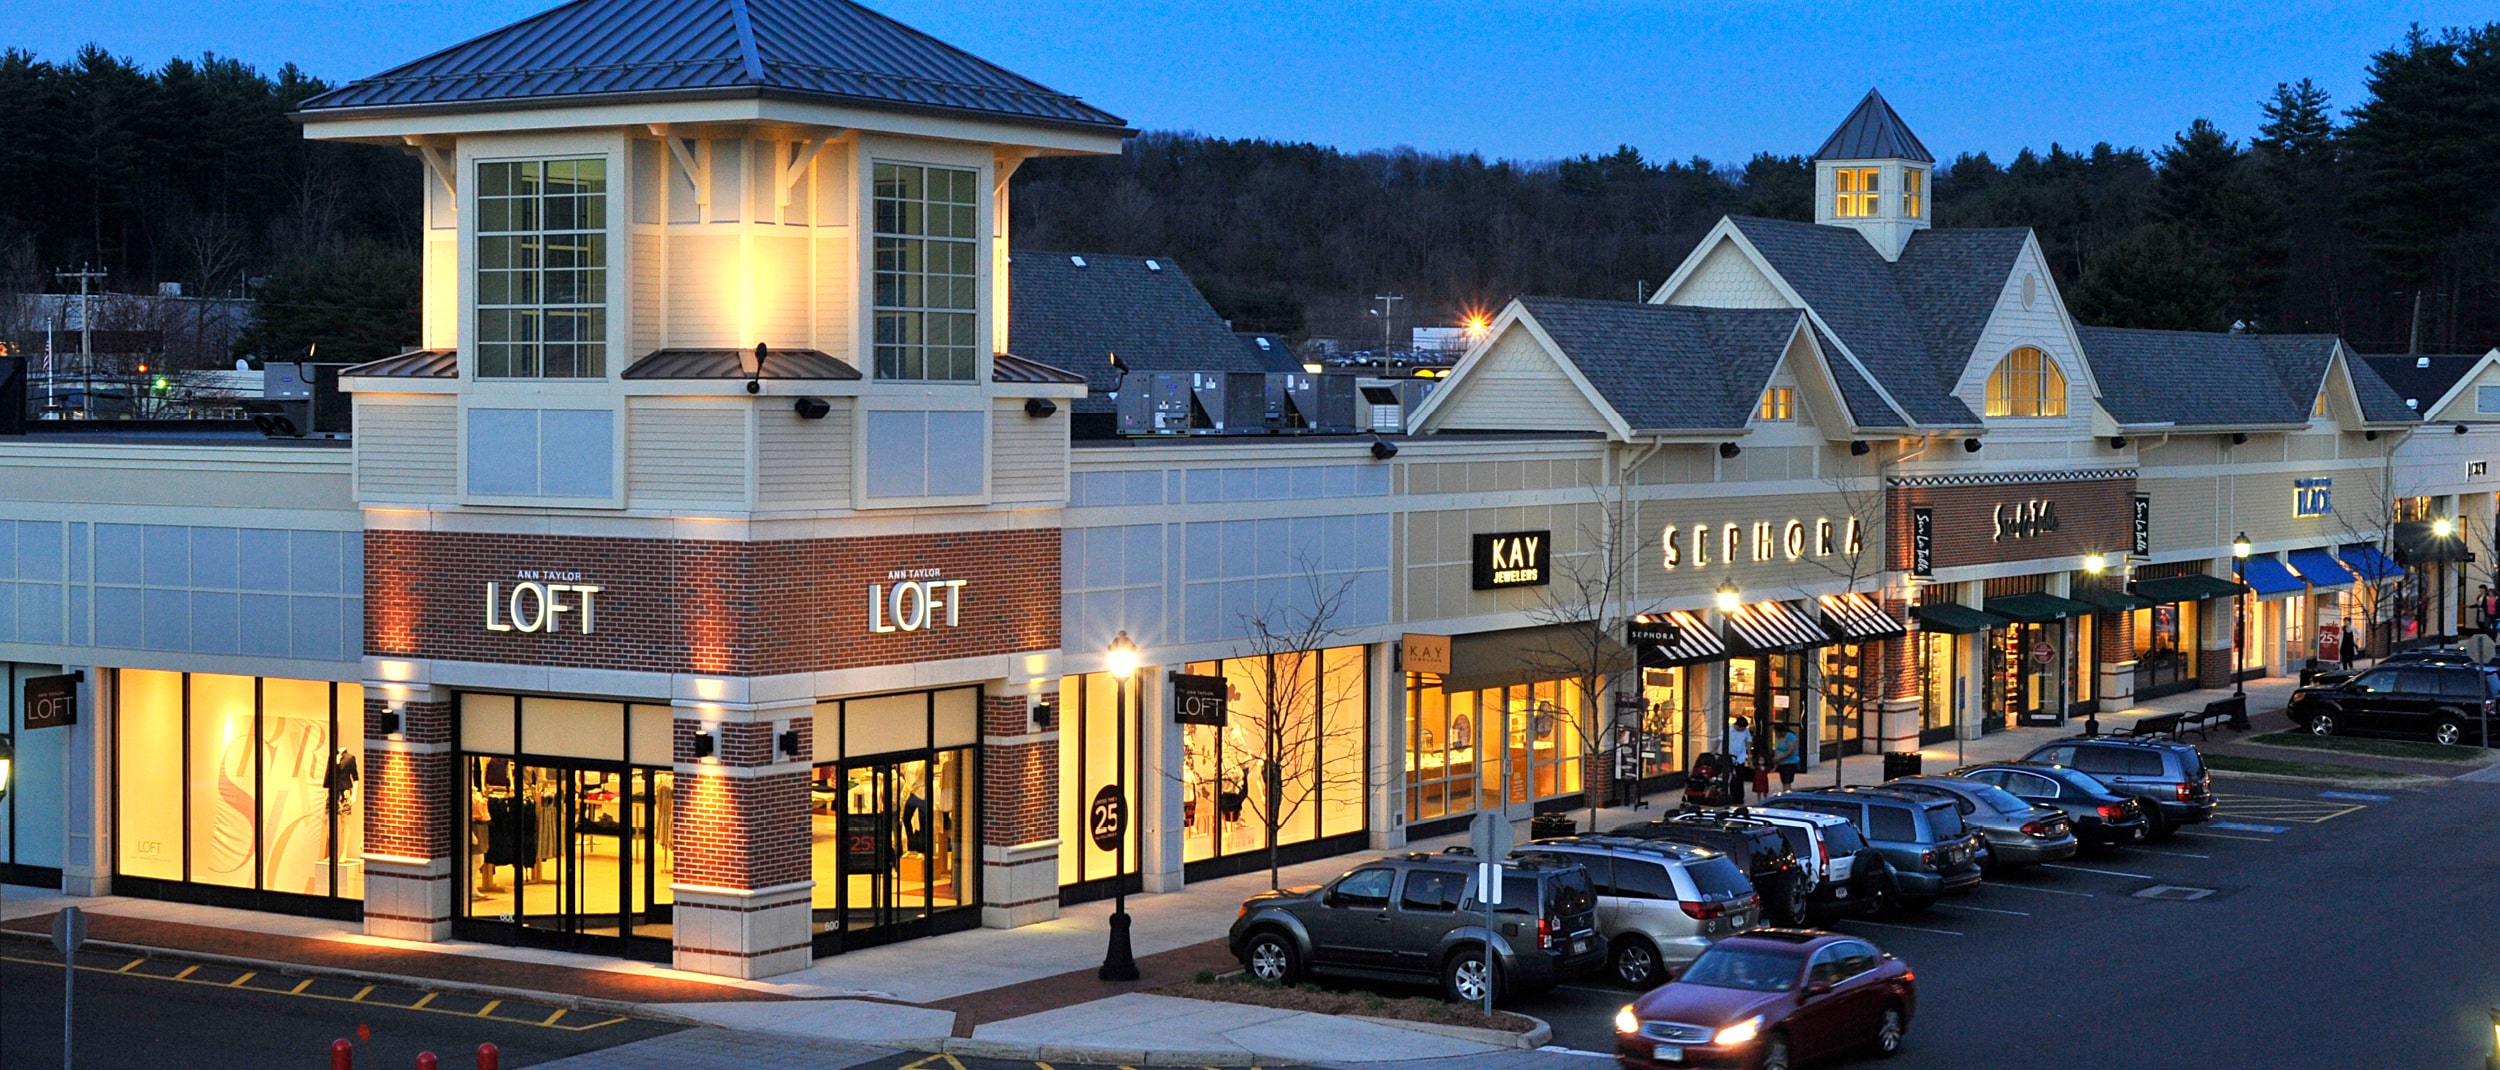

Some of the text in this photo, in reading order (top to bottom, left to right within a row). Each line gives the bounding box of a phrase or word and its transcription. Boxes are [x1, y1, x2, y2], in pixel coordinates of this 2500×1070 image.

[1493, 536, 1539, 569] KAY
[1663, 515, 1863, 569] SEPHORA
[517, 570, 581, 581] ANN TAYLOR
[888, 568, 941, 580] ANN TAYLOR
[1493, 568, 1538, 584] JEWELERS
[486, 581, 605, 635] LOFT
[869, 579, 968, 633] LOFT
[1631, 631, 1675, 640] SEPHORA
[1410, 645, 1442, 658] KAY
[28, 696, 74, 720] LOFT
[1177, 695, 1223, 717] LOFT
[1095, 803, 1118, 835] 25
[137, 840, 163, 854] LOFT
